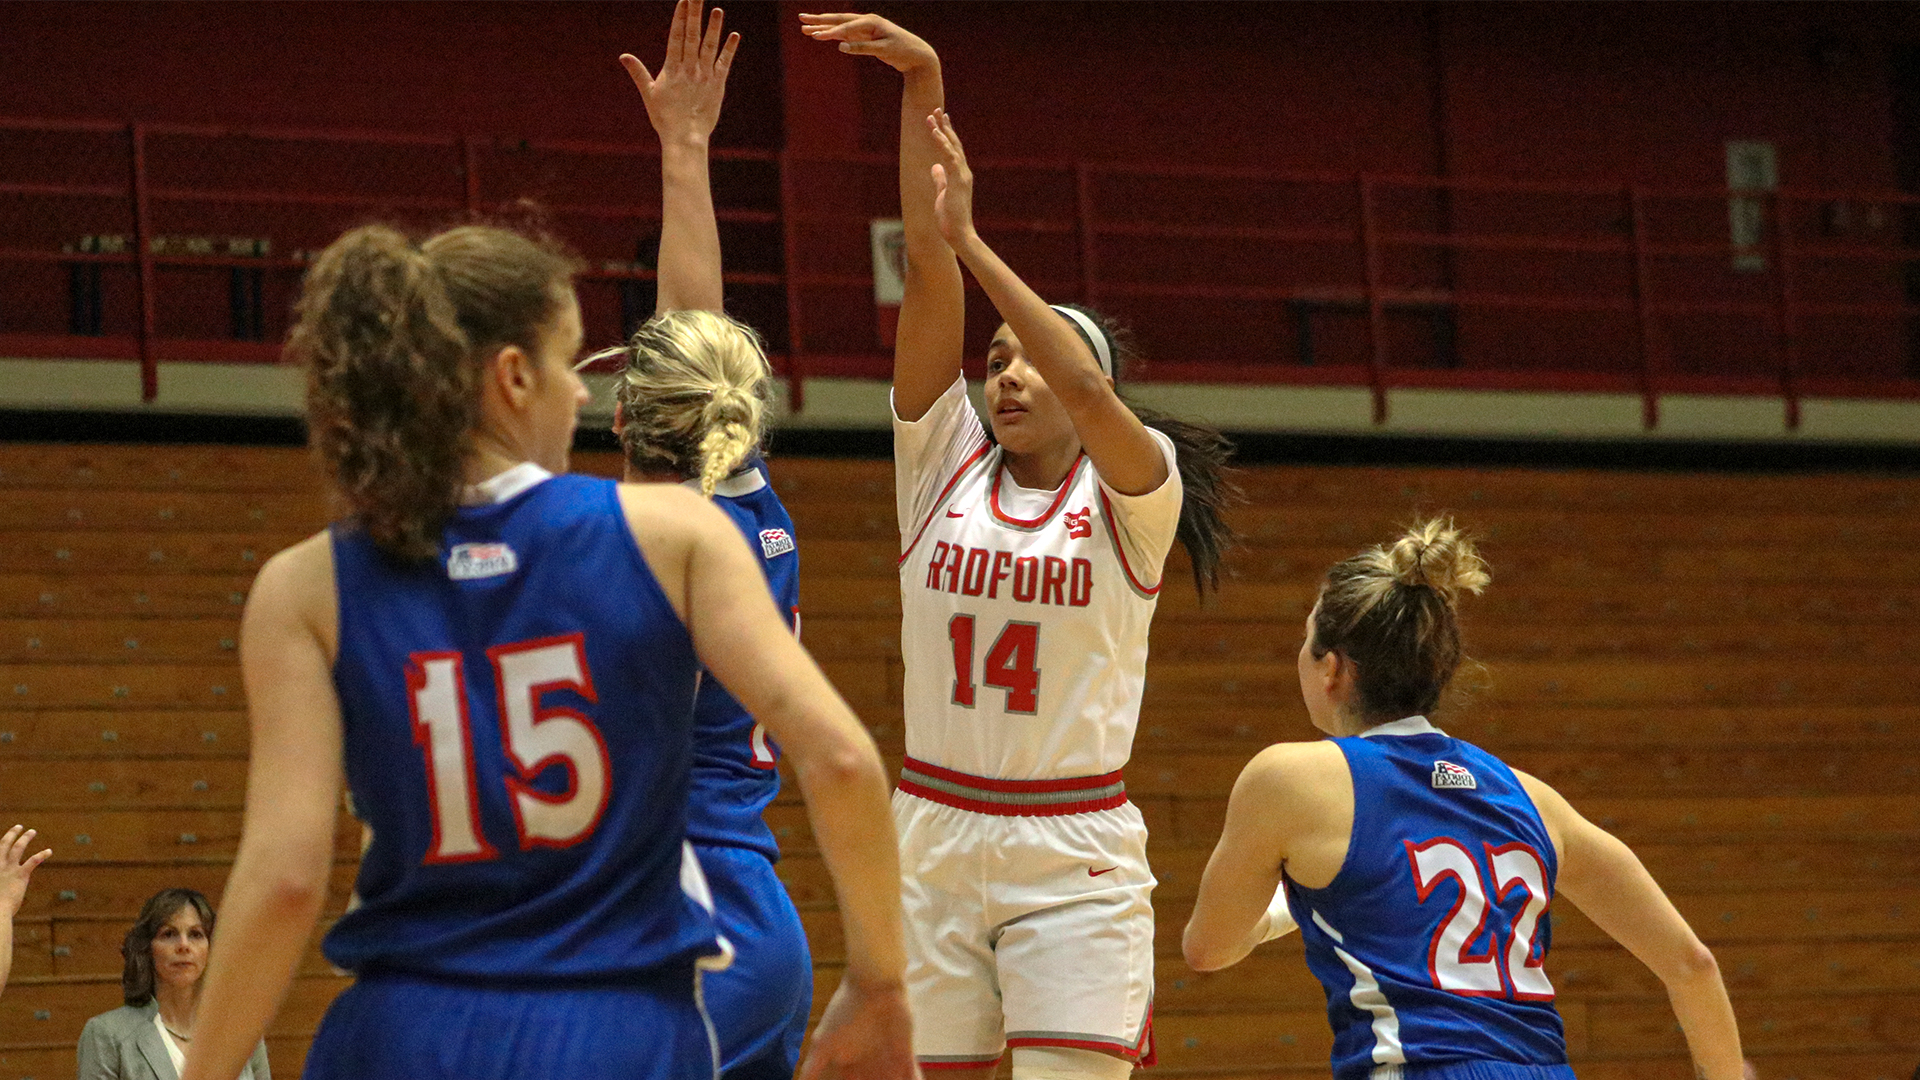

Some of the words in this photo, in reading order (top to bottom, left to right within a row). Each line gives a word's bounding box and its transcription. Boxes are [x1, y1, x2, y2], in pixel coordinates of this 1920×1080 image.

[925, 540, 1094, 607] RADFORD
[948, 612, 1041, 716] 14
[403, 630, 612, 866] 15
[1435, 773, 1472, 781] PATRIOT
[1435, 779, 1474, 787] LEAGUE
[1403, 836, 1555, 1001] 22
